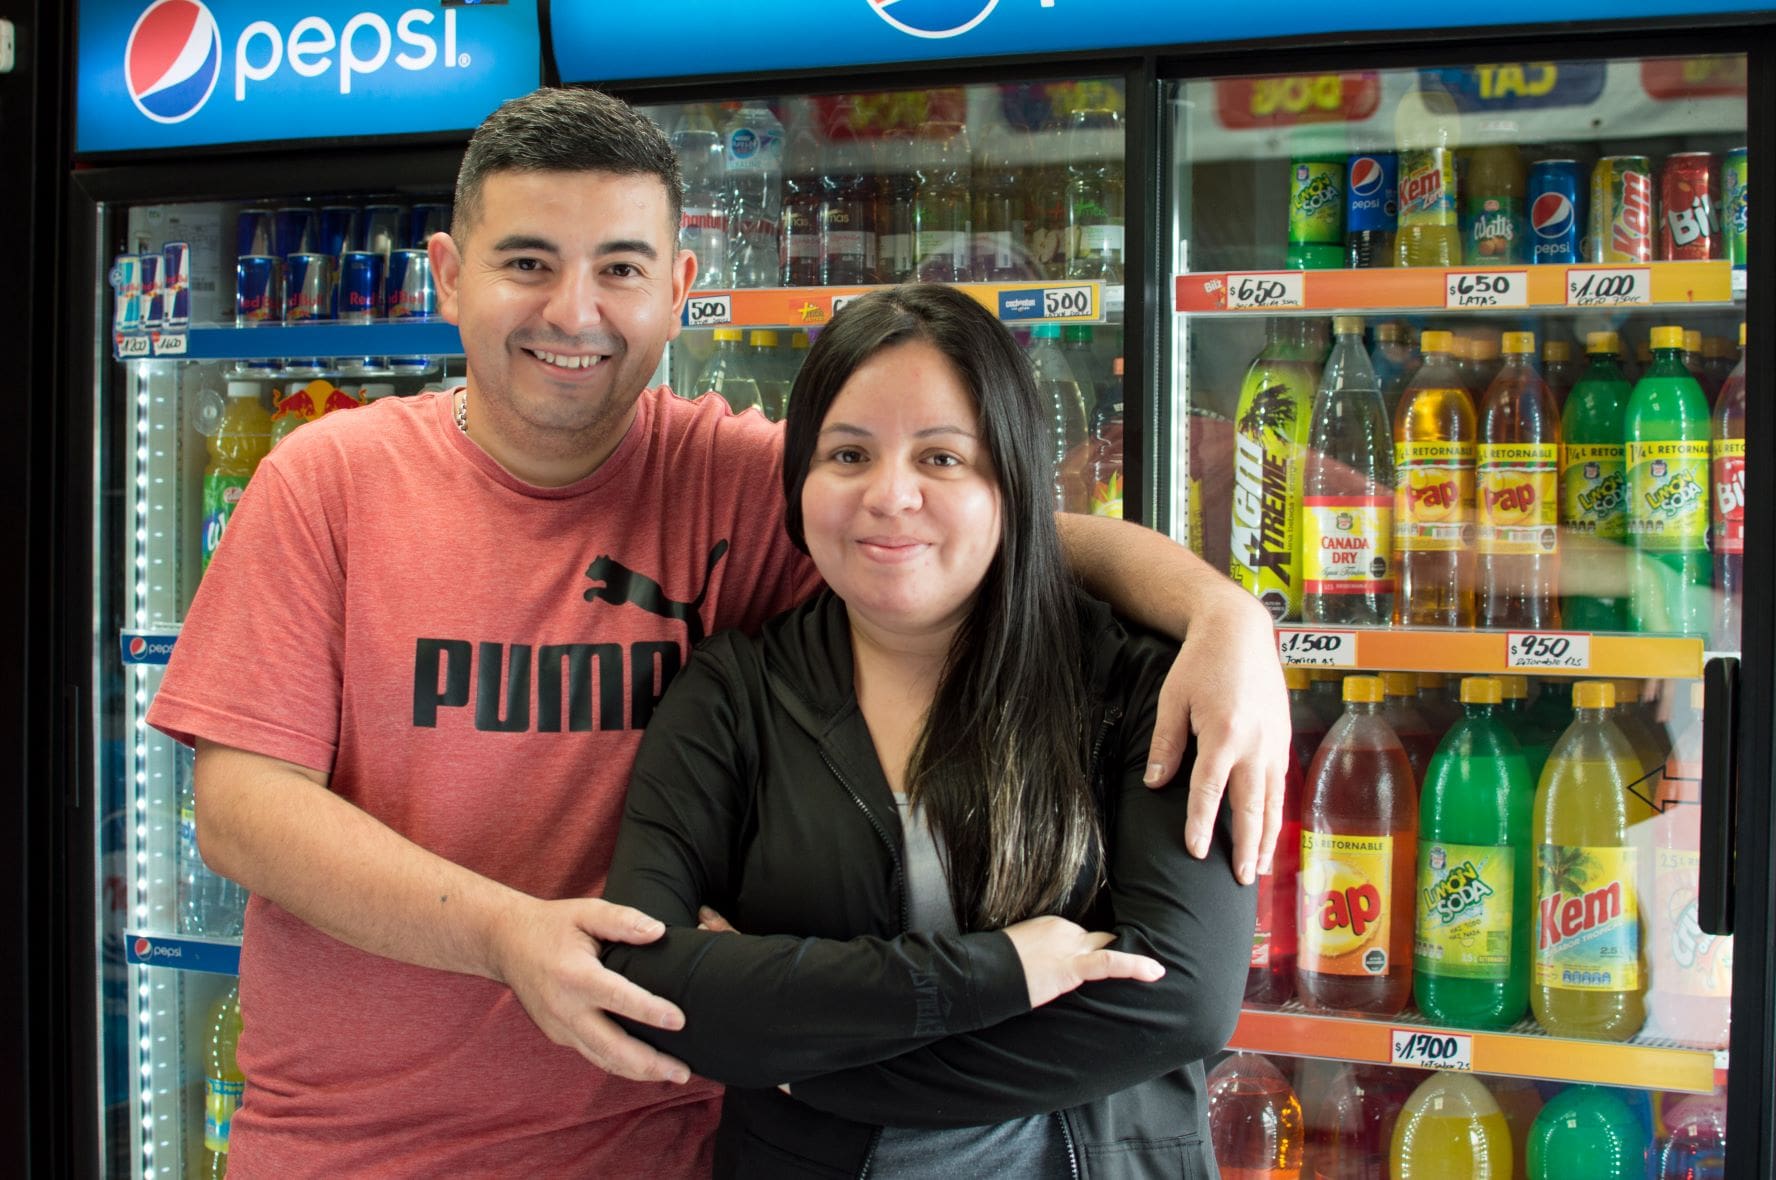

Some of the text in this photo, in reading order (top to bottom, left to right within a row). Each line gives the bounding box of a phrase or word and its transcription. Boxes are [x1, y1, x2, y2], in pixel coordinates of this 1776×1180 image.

[235, 8, 456, 101] pepsi
[1302, 185, 1341, 216] SODA
[1398, 169, 1441, 208] Kem
[1352, 198, 1380, 211] pepsi
[1612, 169, 1651, 262] Kem
[1667, 193, 1720, 247] Bil
[1534, 241, 1571, 256] pepsi
[691, 301, 726, 320] 500
[1046, 290, 1088, 314] 500
[1459, 296, 1497, 305] LATAS
[1490, 449, 1552, 458] RETORNABLE
[1231, 431, 1264, 574] Kem
[1661, 481, 1703, 518] SODA
[1717, 470, 1745, 514] Bil
[1250, 447, 1292, 588] XTREME
[1321, 536, 1369, 550] CANADA
[1332, 552, 1358, 564] DRY
[149, 644, 174, 655] peps
[413, 637, 682, 733] PUMA
[1321, 840, 1384, 851] RETORNABLE
[1437, 880, 1494, 924] SODA
[1539, 880, 1620, 951] Kem
[153, 946, 182, 957] pepsi
